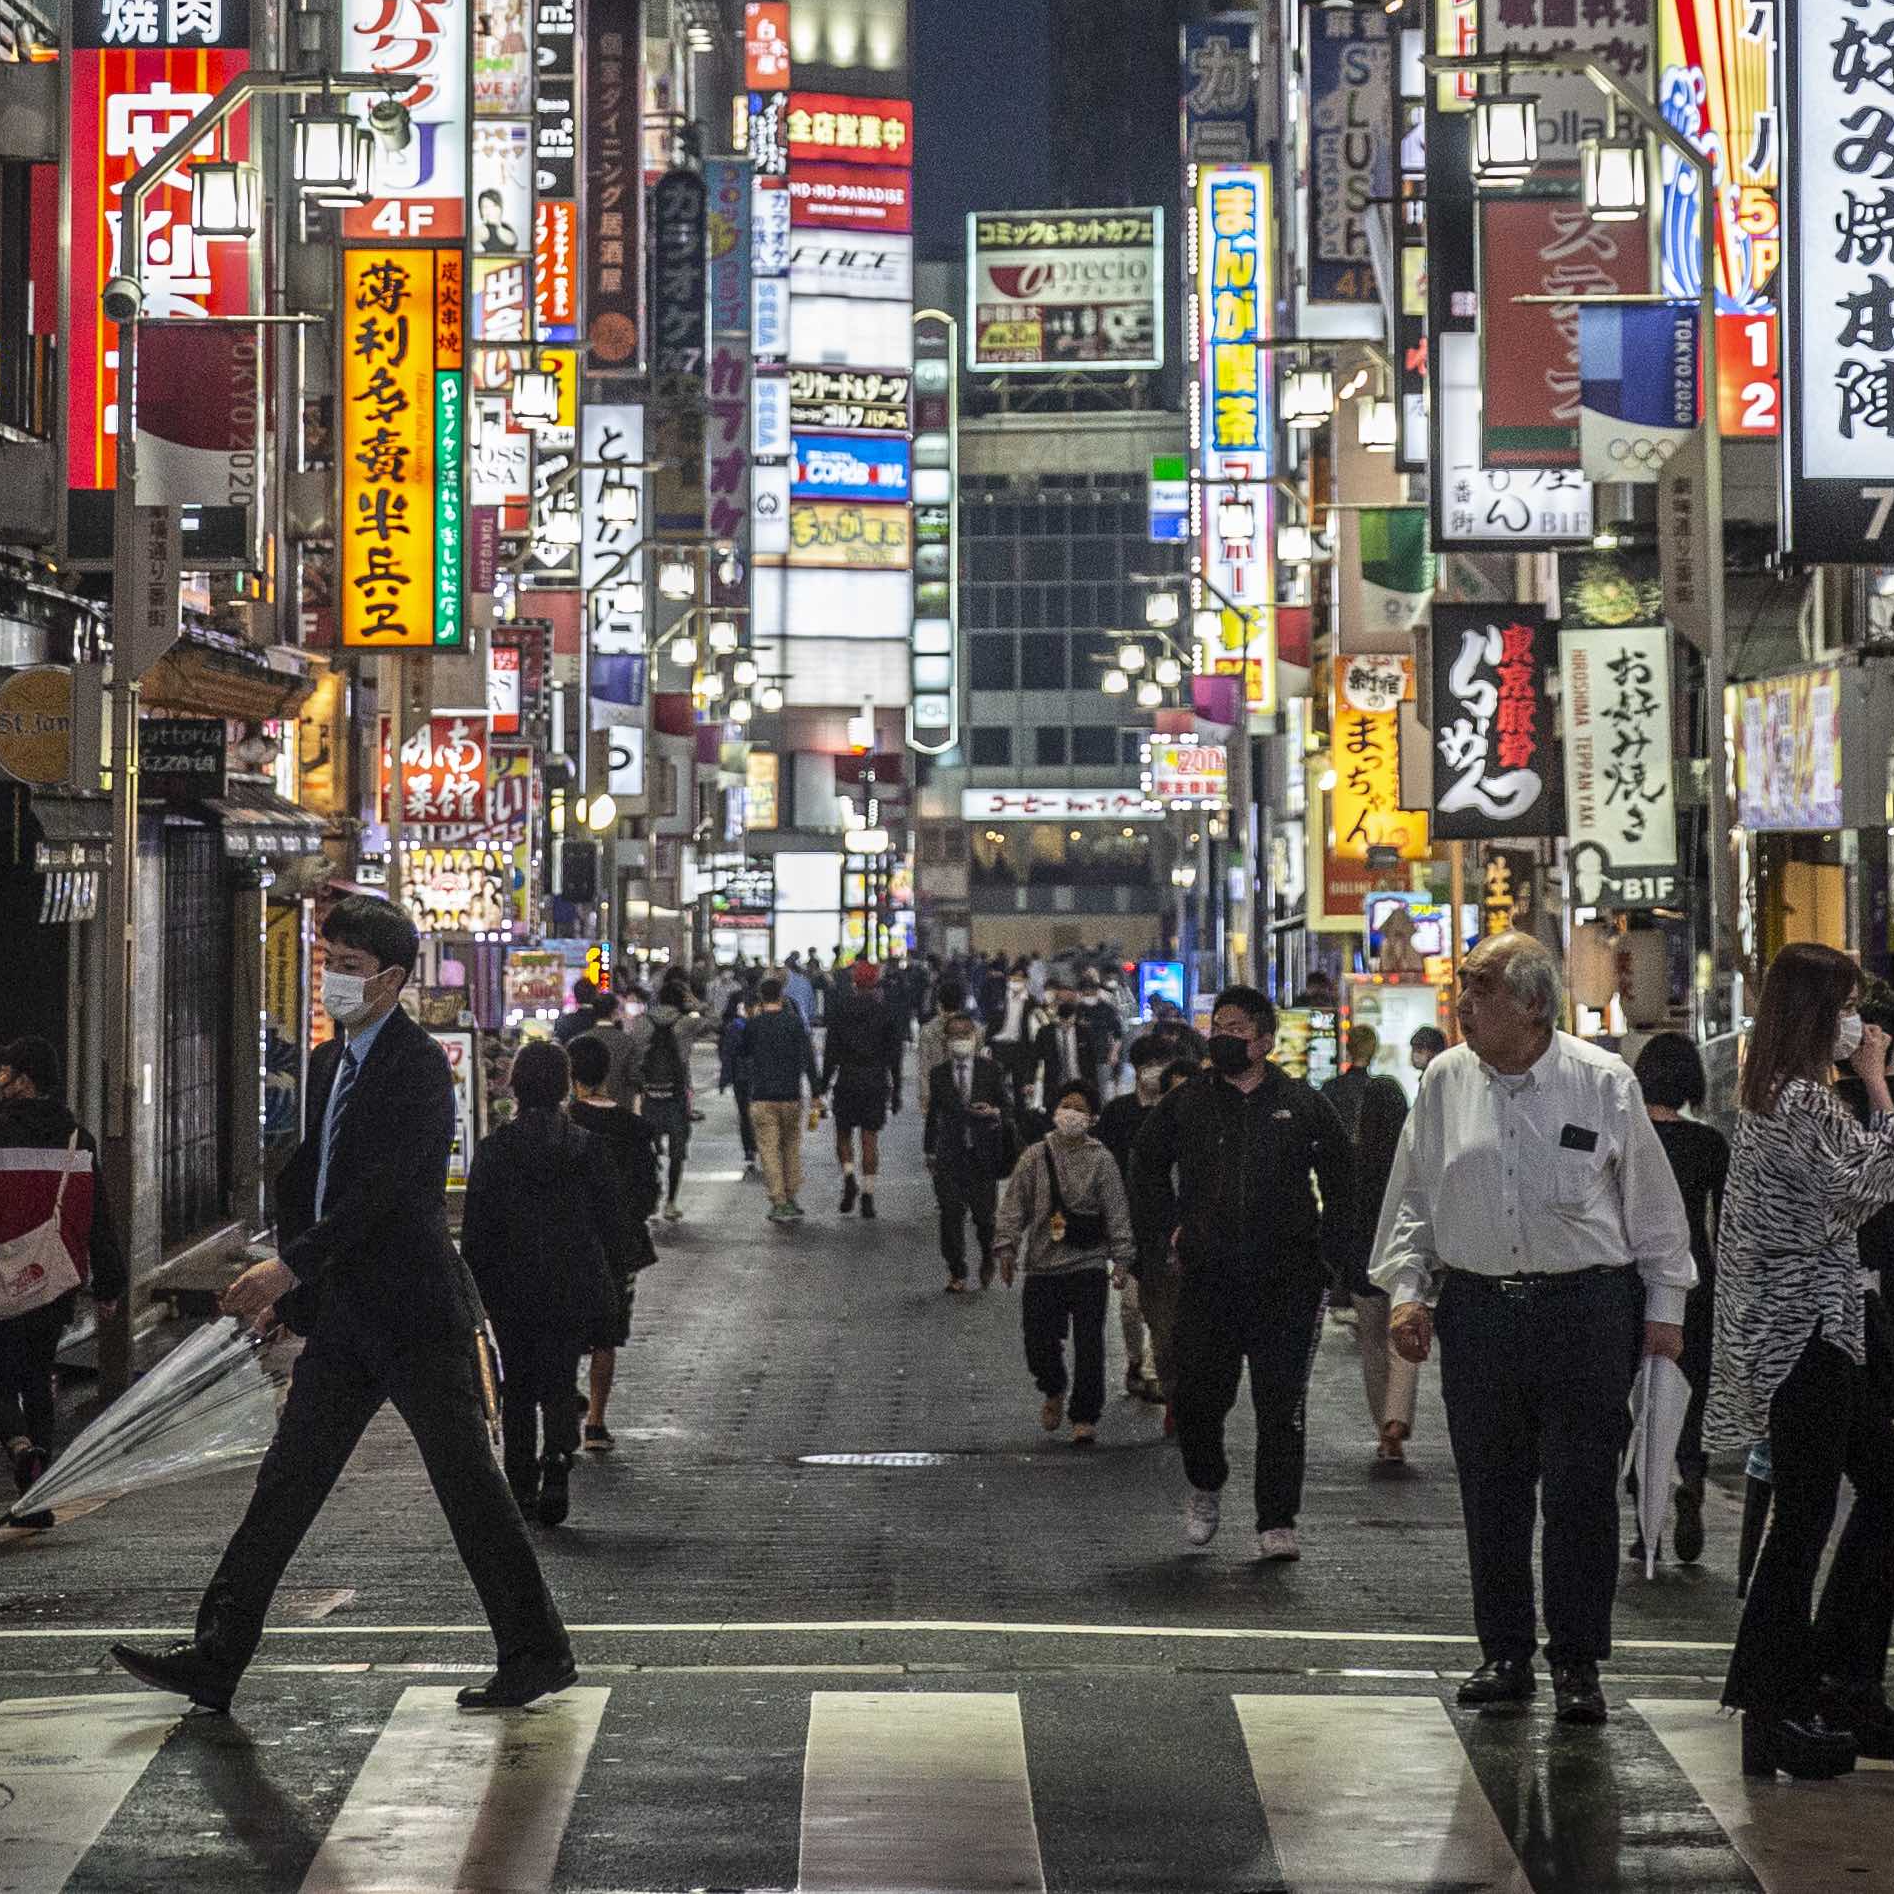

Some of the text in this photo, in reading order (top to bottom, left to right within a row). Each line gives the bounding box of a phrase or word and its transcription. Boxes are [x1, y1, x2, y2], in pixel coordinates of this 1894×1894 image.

[788, 110, 906, 150] 全店営業中
[371, 202, 436, 237] 4F
[1452, 464, 1474, 532] 一番街
[1622, 877, 1675, 900] B1F
